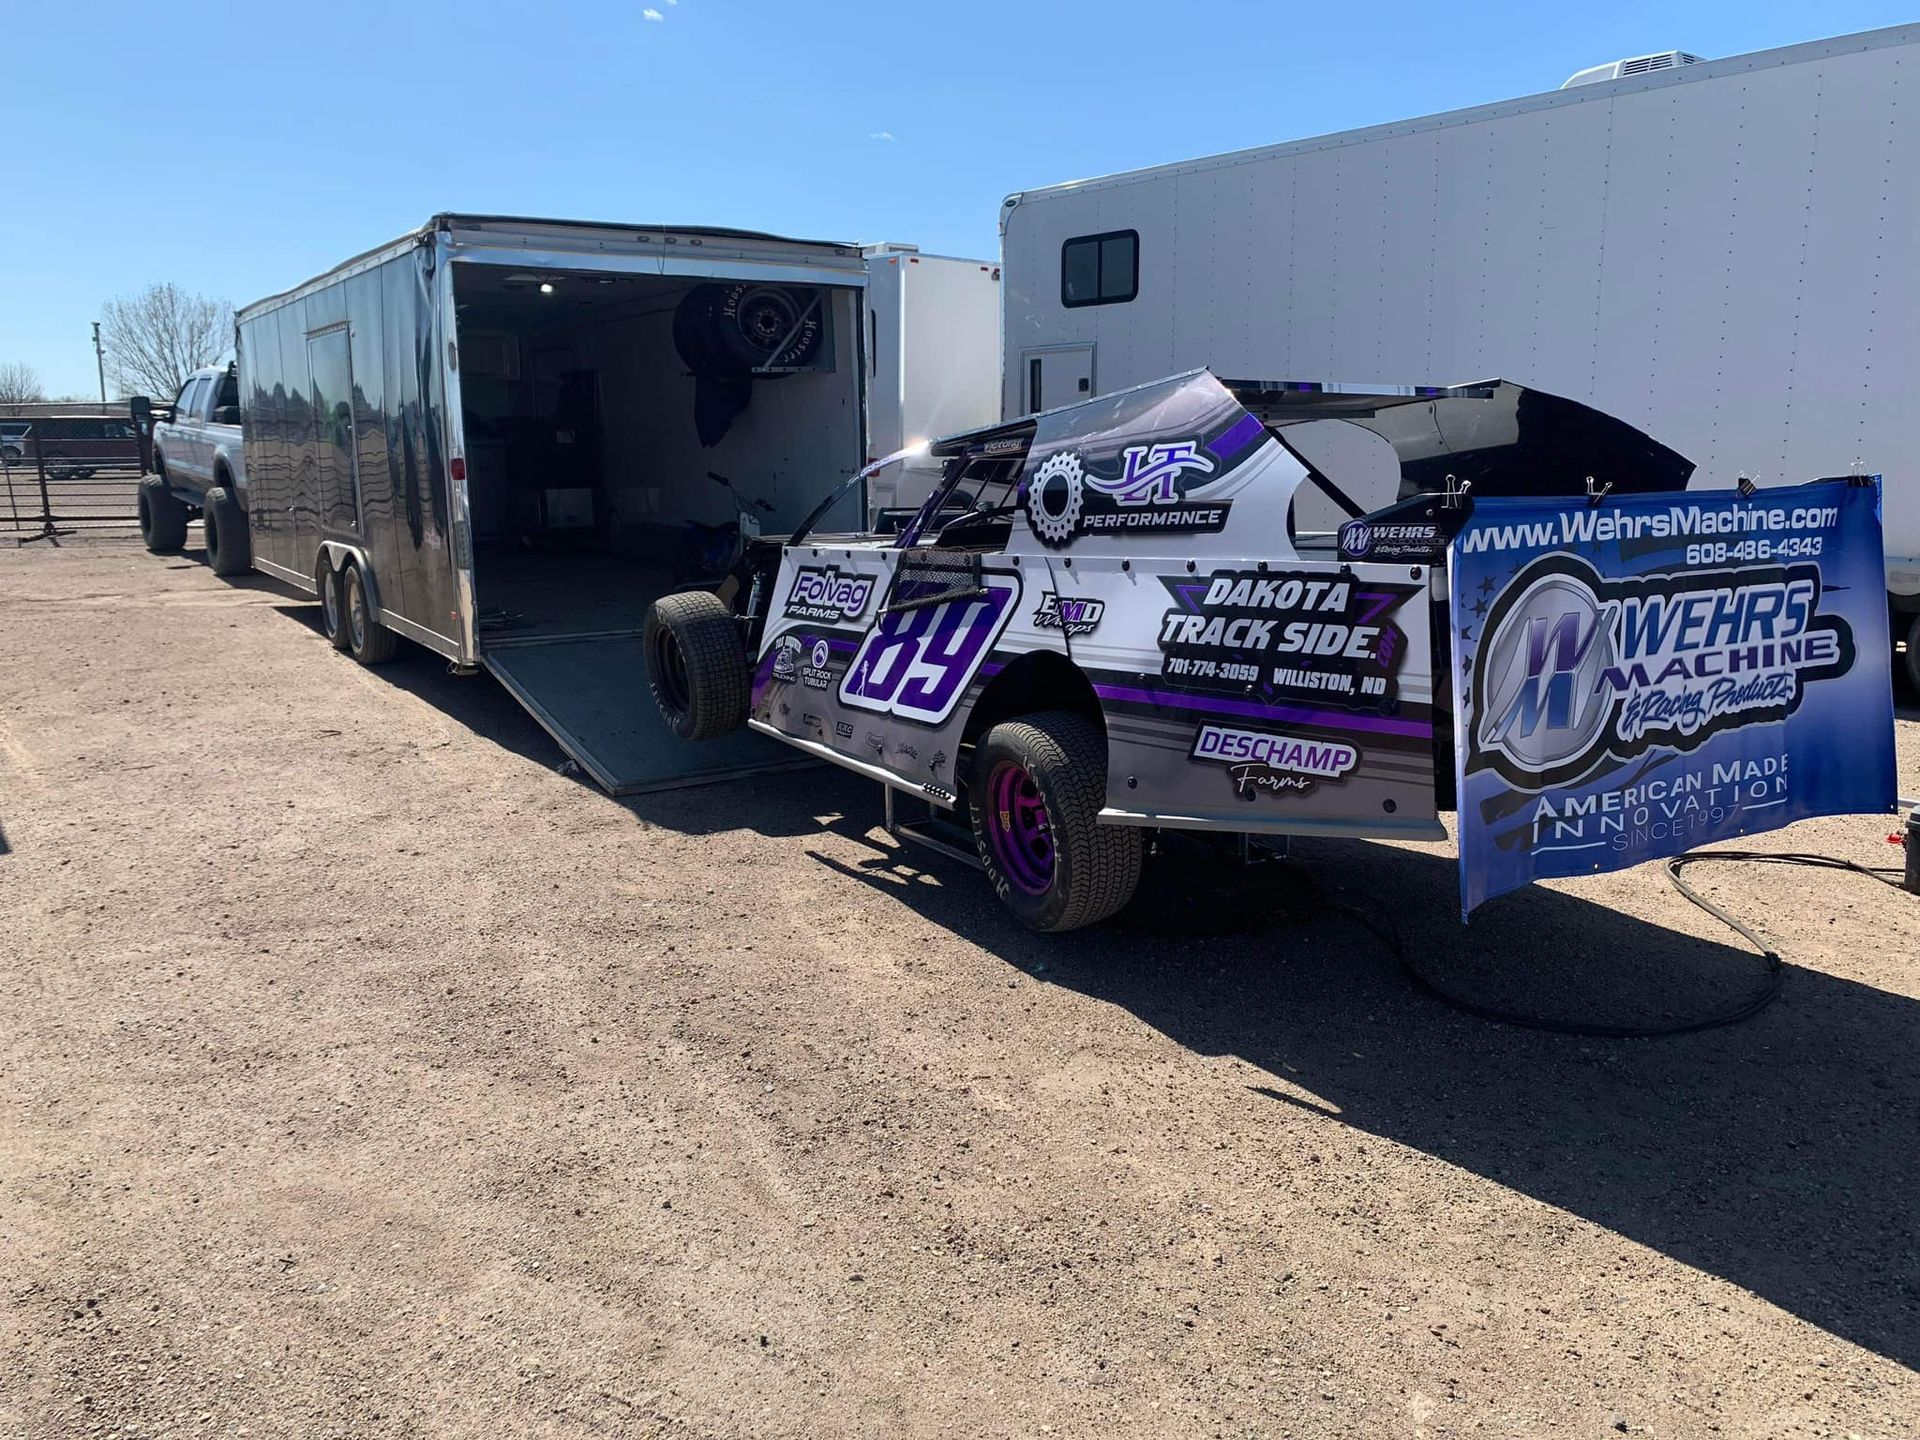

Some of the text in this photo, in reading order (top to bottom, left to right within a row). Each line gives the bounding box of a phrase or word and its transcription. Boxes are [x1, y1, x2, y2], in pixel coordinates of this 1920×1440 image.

[1112, 441, 1203, 506] LT
[1083, 509, 1222, 528] PERFORMANCE
[1373, 526, 1436, 538] WEHRS
[1462, 505, 1838, 553] www.WehrsMachine.com
[1686, 537, 1822, 565] 608-486-4343
[787, 605, 840, 620] FARMS
[793, 571, 870, 613] Folvag
[1040, 594, 1103, 622] EMD
[1203, 578, 1350, 612] DAKOTA
[1161, 614, 1279, 650] TRACK
[1278, 622, 1380, 659] SIDE.
[1624, 581, 1812, 660] WEHRS
[844, 579, 1013, 713] 89
[1594, 634, 1836, 693] MACHINE
[804, 677, 828, 688] TUBULAR
[816, 669, 832, 680] ROCK
[1273, 668, 1355, 696] WILLISTON,
[1361, 676, 1387, 695] ND
[1707, 673, 1793, 714] Products
[1201, 731, 1351, 772] DESCHAMP
[1230, 763, 1311, 793] Farms
[1531, 754, 1789, 823] AMERICAN MADE
[1532, 775, 1789, 844] INNOVATION
